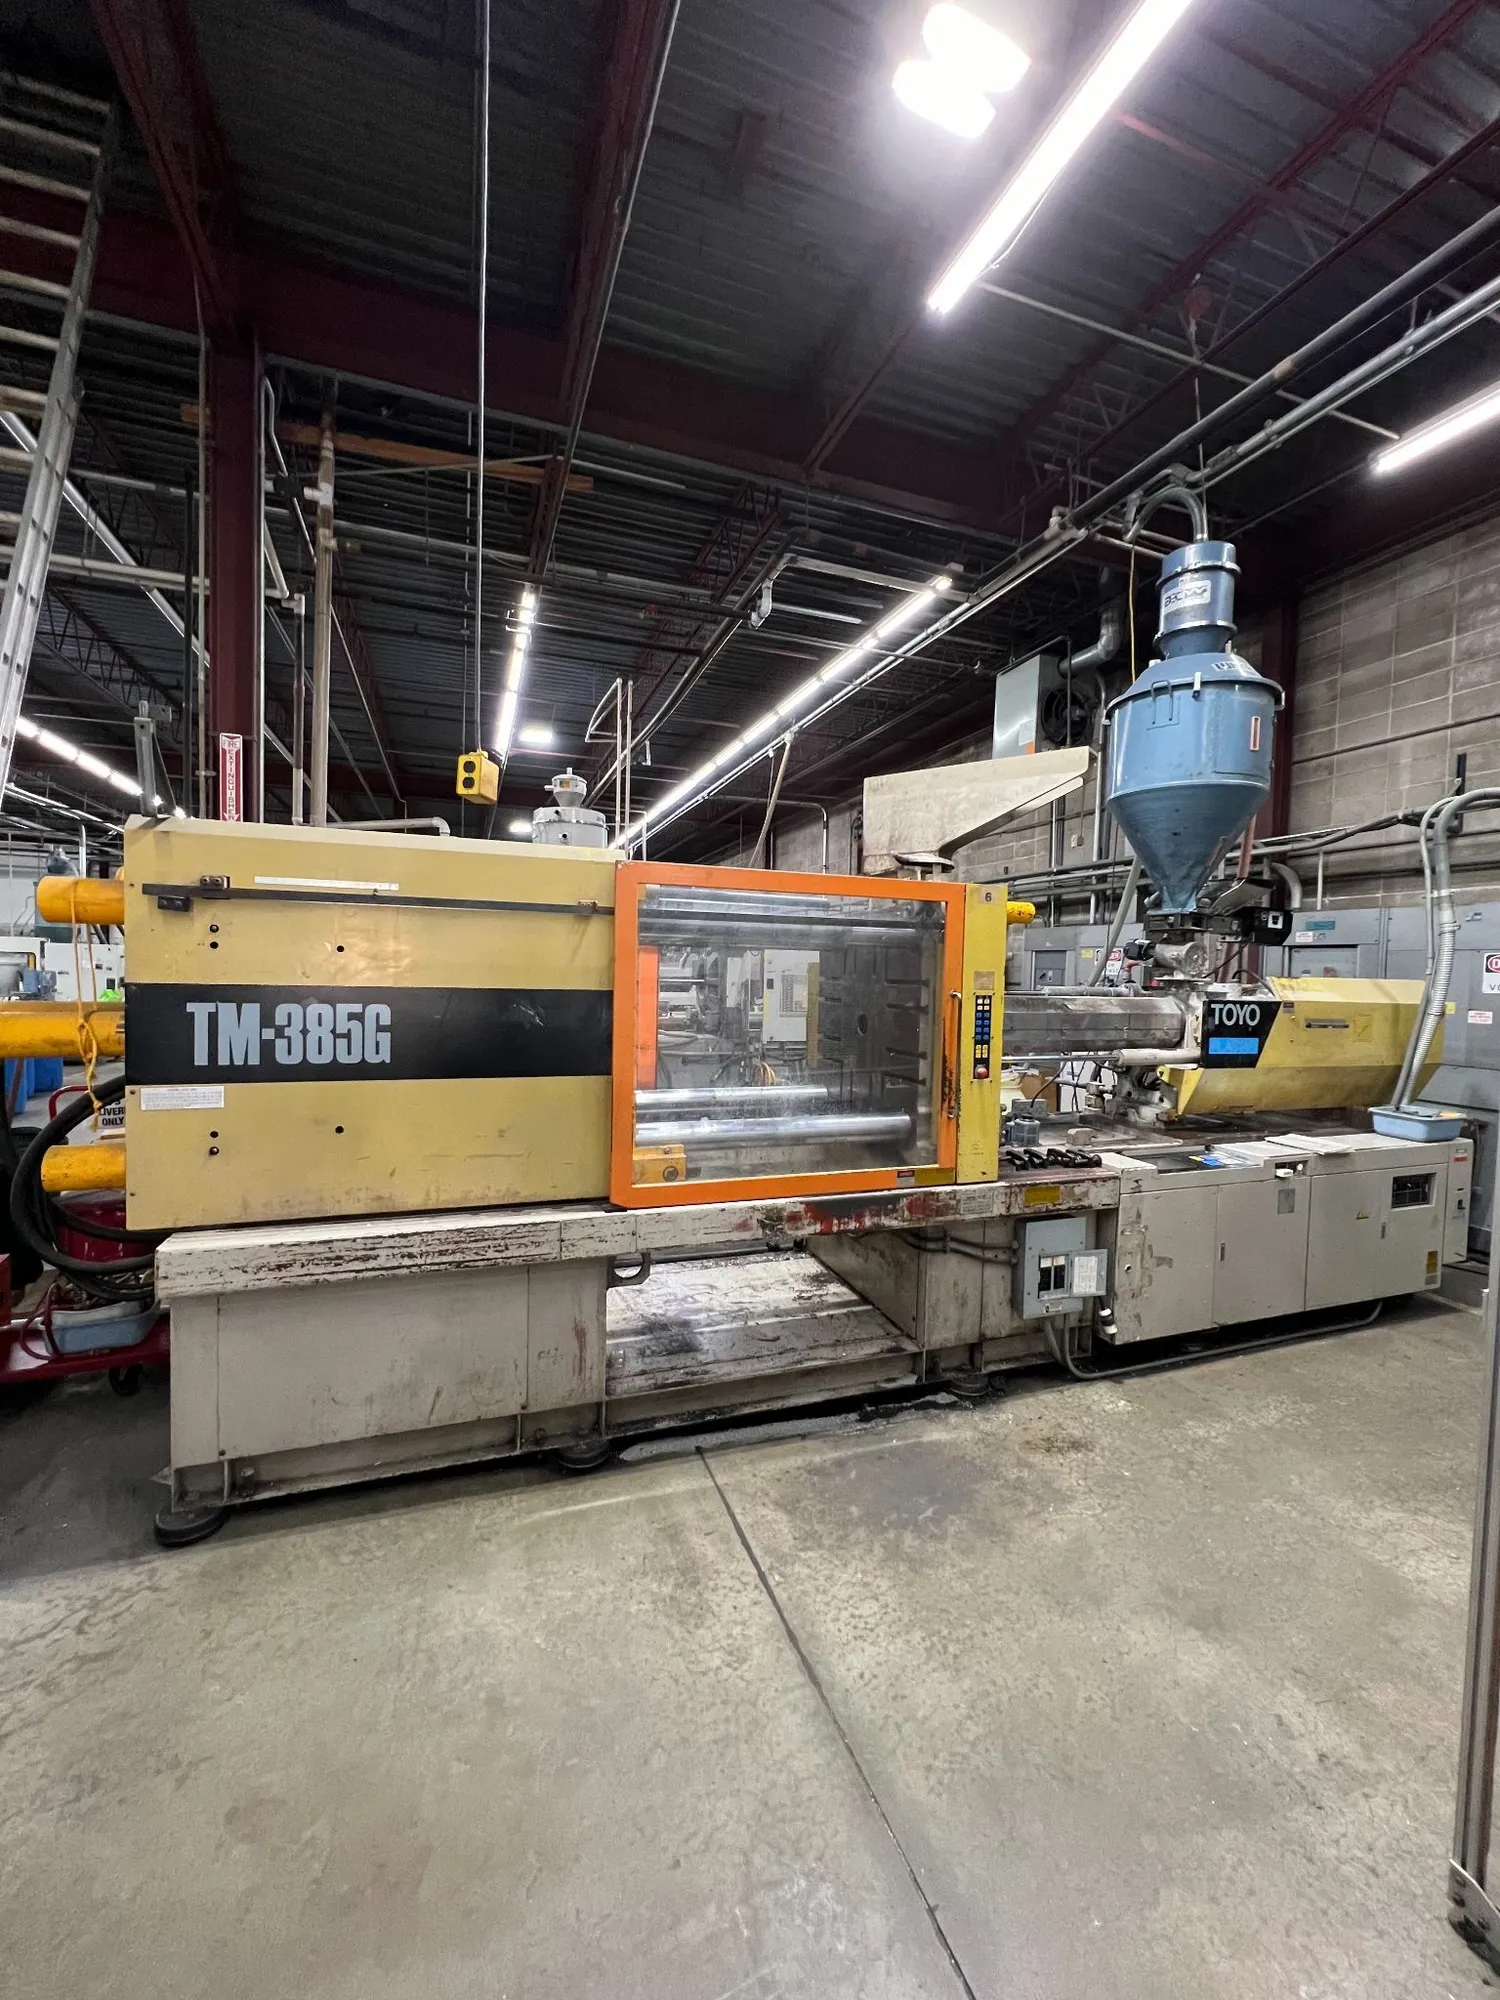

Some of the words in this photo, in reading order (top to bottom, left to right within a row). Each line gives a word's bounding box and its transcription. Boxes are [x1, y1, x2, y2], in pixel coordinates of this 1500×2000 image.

[222, 740, 241, 748] FIRE
[985, 892, 992, 902] 6
[1210, 1003, 1261, 1026] TOYO
[187, 1001, 392, 1067] TM-385G
[102, 1116, 125, 1126] ONLY
